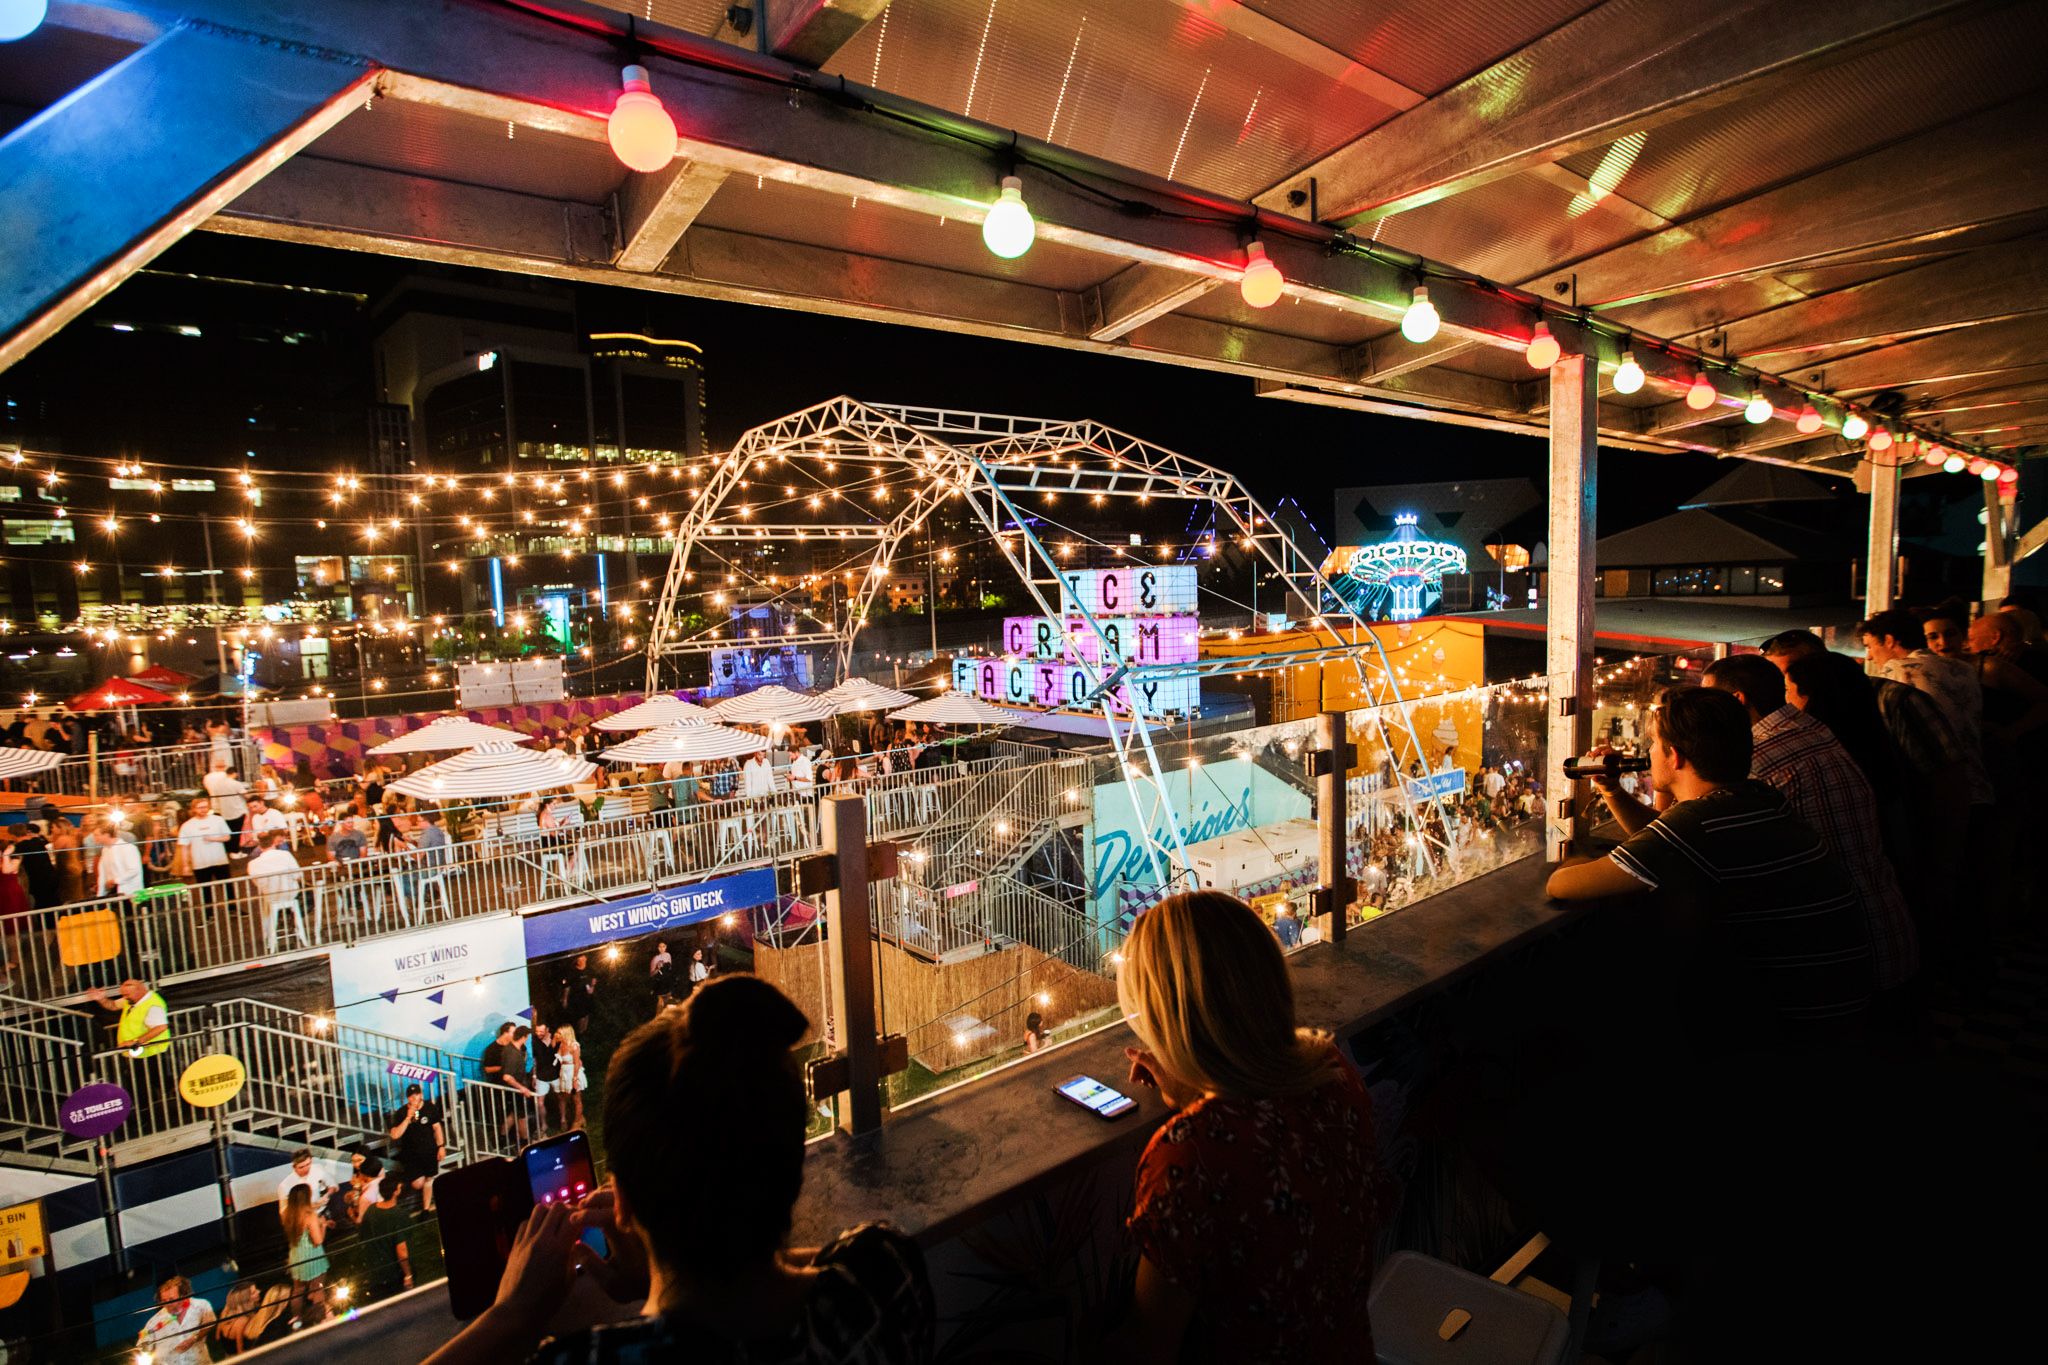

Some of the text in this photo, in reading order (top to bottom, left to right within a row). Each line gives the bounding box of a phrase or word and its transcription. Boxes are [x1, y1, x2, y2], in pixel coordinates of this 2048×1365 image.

[954, 884, 971, 895] EXIT
[589, 889, 724, 933] WEST WINDS GIN DECK
[395, 952, 426, 971] WEST
[430, 944, 468, 962] WINDS
[423, 973, 445, 985] GIN
[391, 1062, 433, 1081] ENTRY
[84, 1098, 122, 1115] TOILETS
[7, 1211, 26, 1224] BIN
